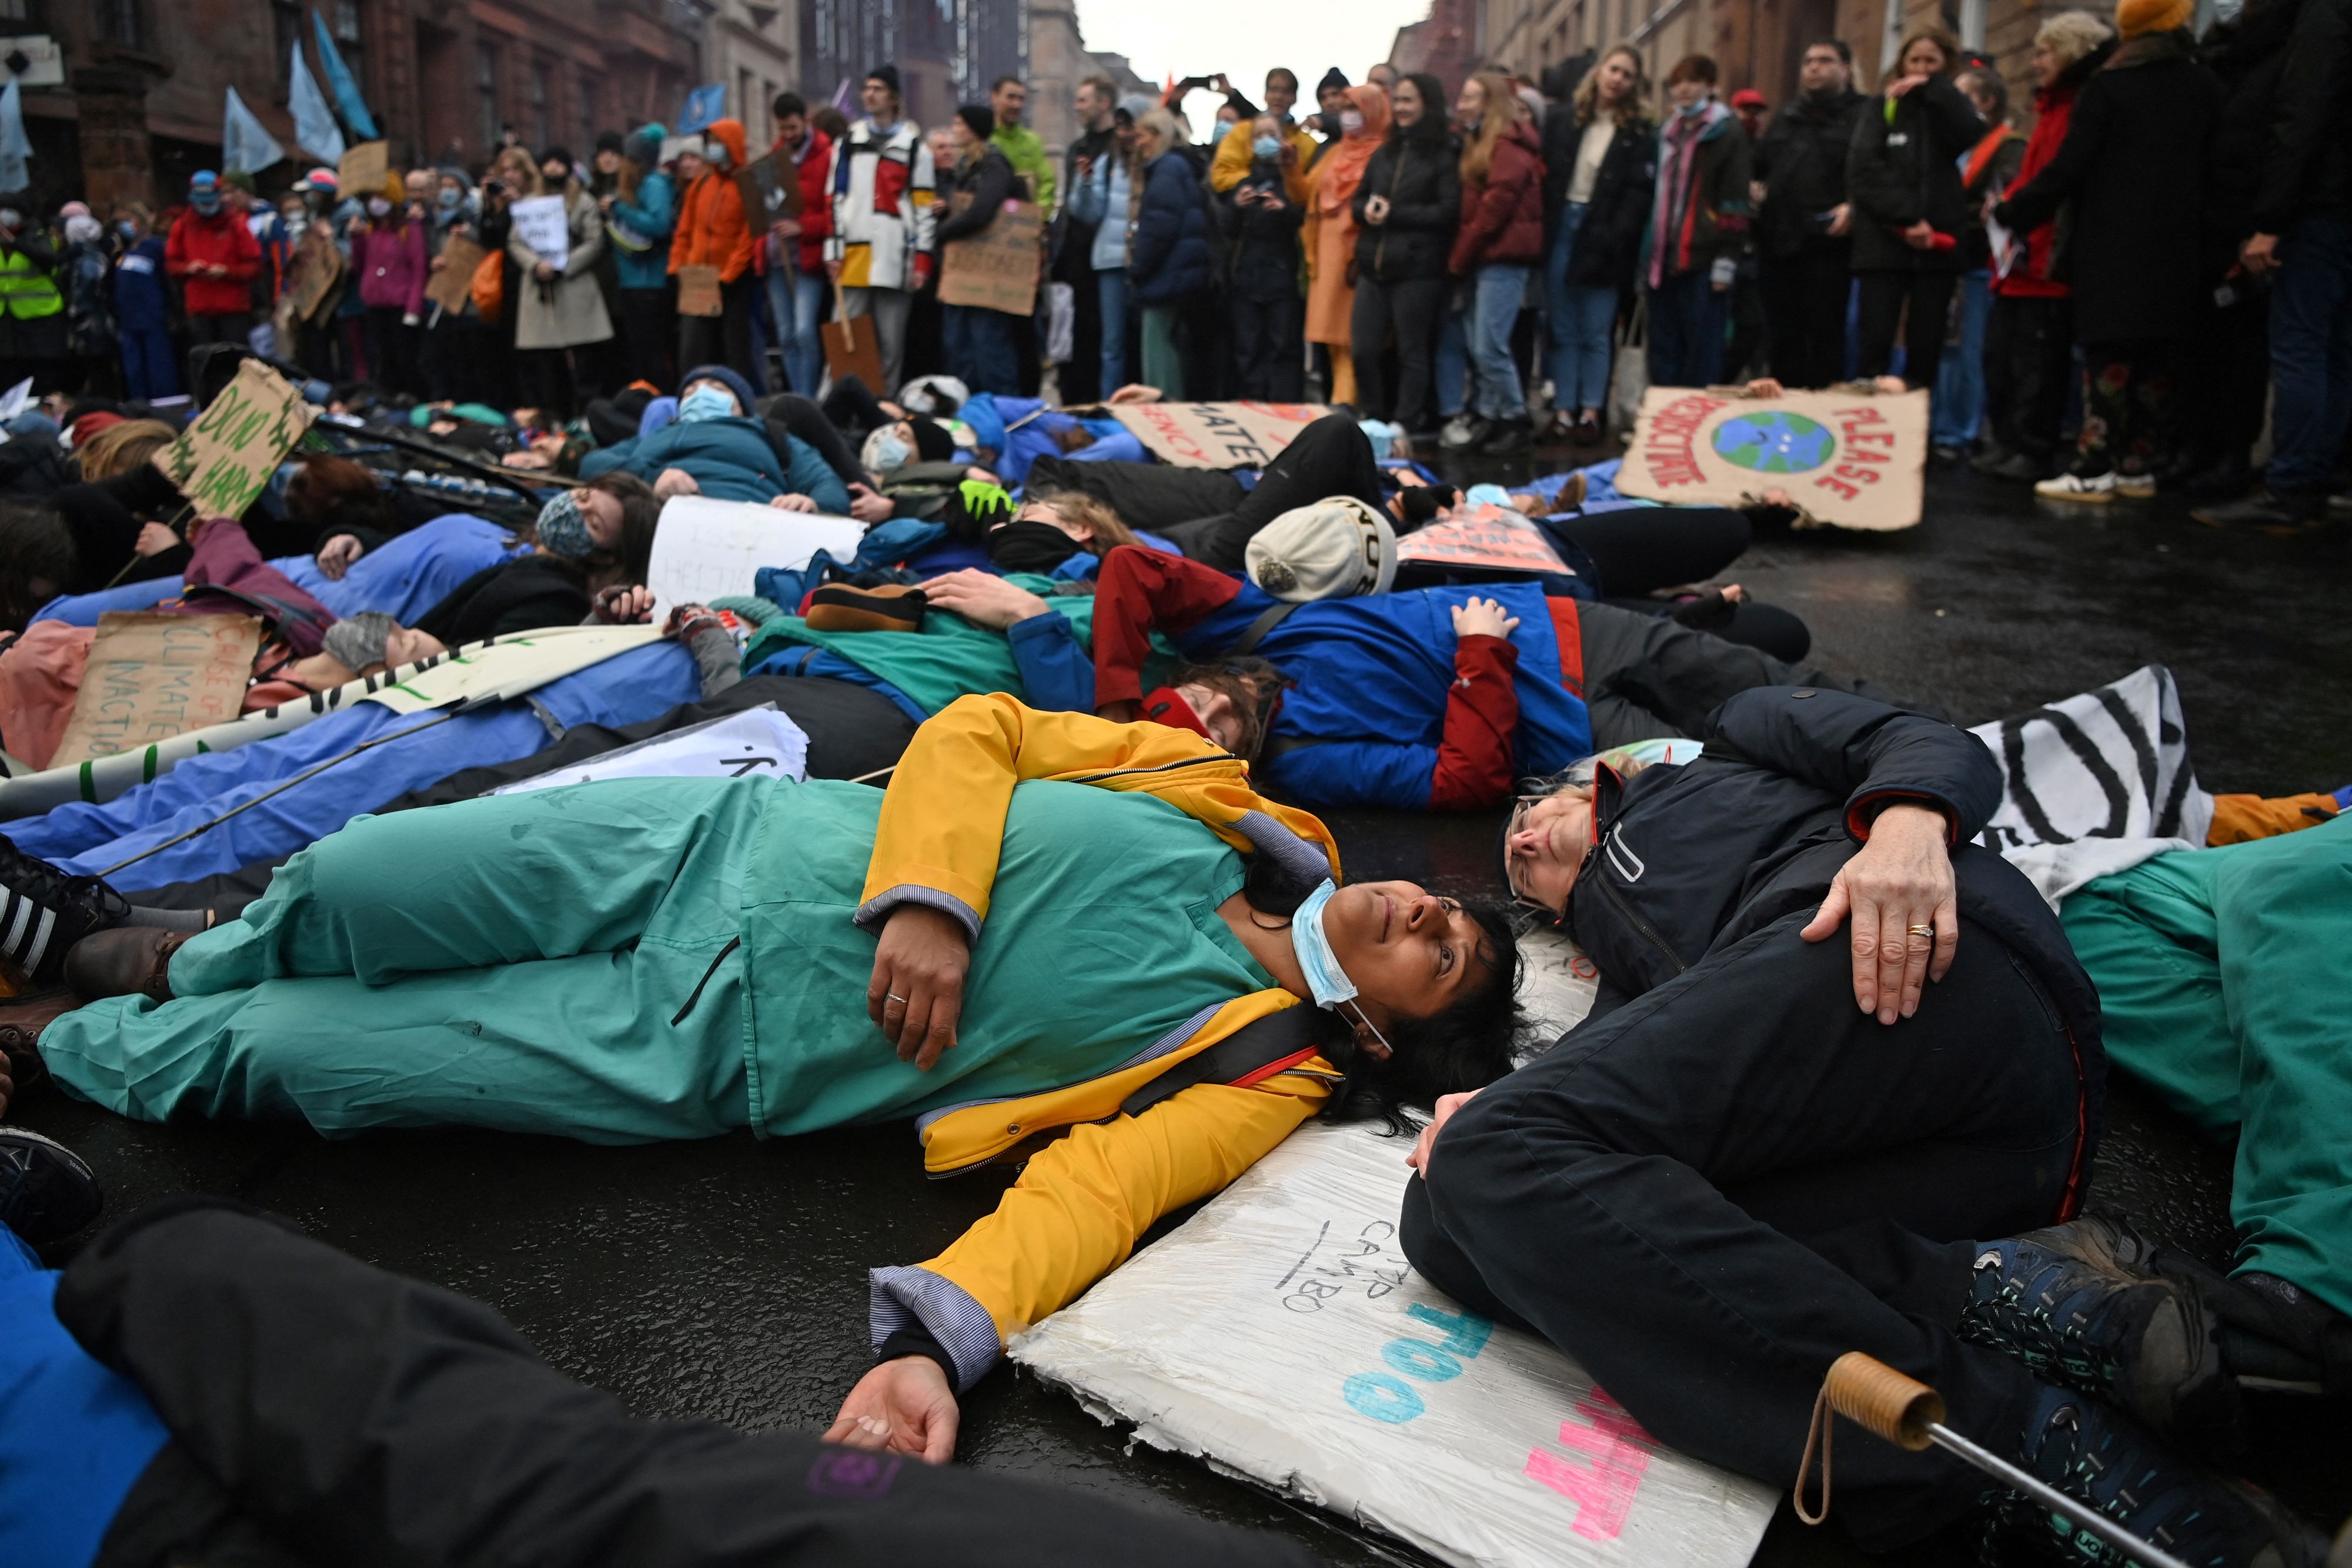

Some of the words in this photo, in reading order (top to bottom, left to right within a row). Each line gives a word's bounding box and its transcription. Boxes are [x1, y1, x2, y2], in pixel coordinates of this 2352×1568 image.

[196, 385, 252, 442] DO
[1814, 407, 1895, 501] PLEASE
[192, 455, 265, 519] HARM
[88, 660, 146, 758] INACTIO
[148, 625, 212, 735] CLIMATE
[1281, 1220, 1396, 1313] CAMBO
[1342, 1302, 1494, 1425] TOO
